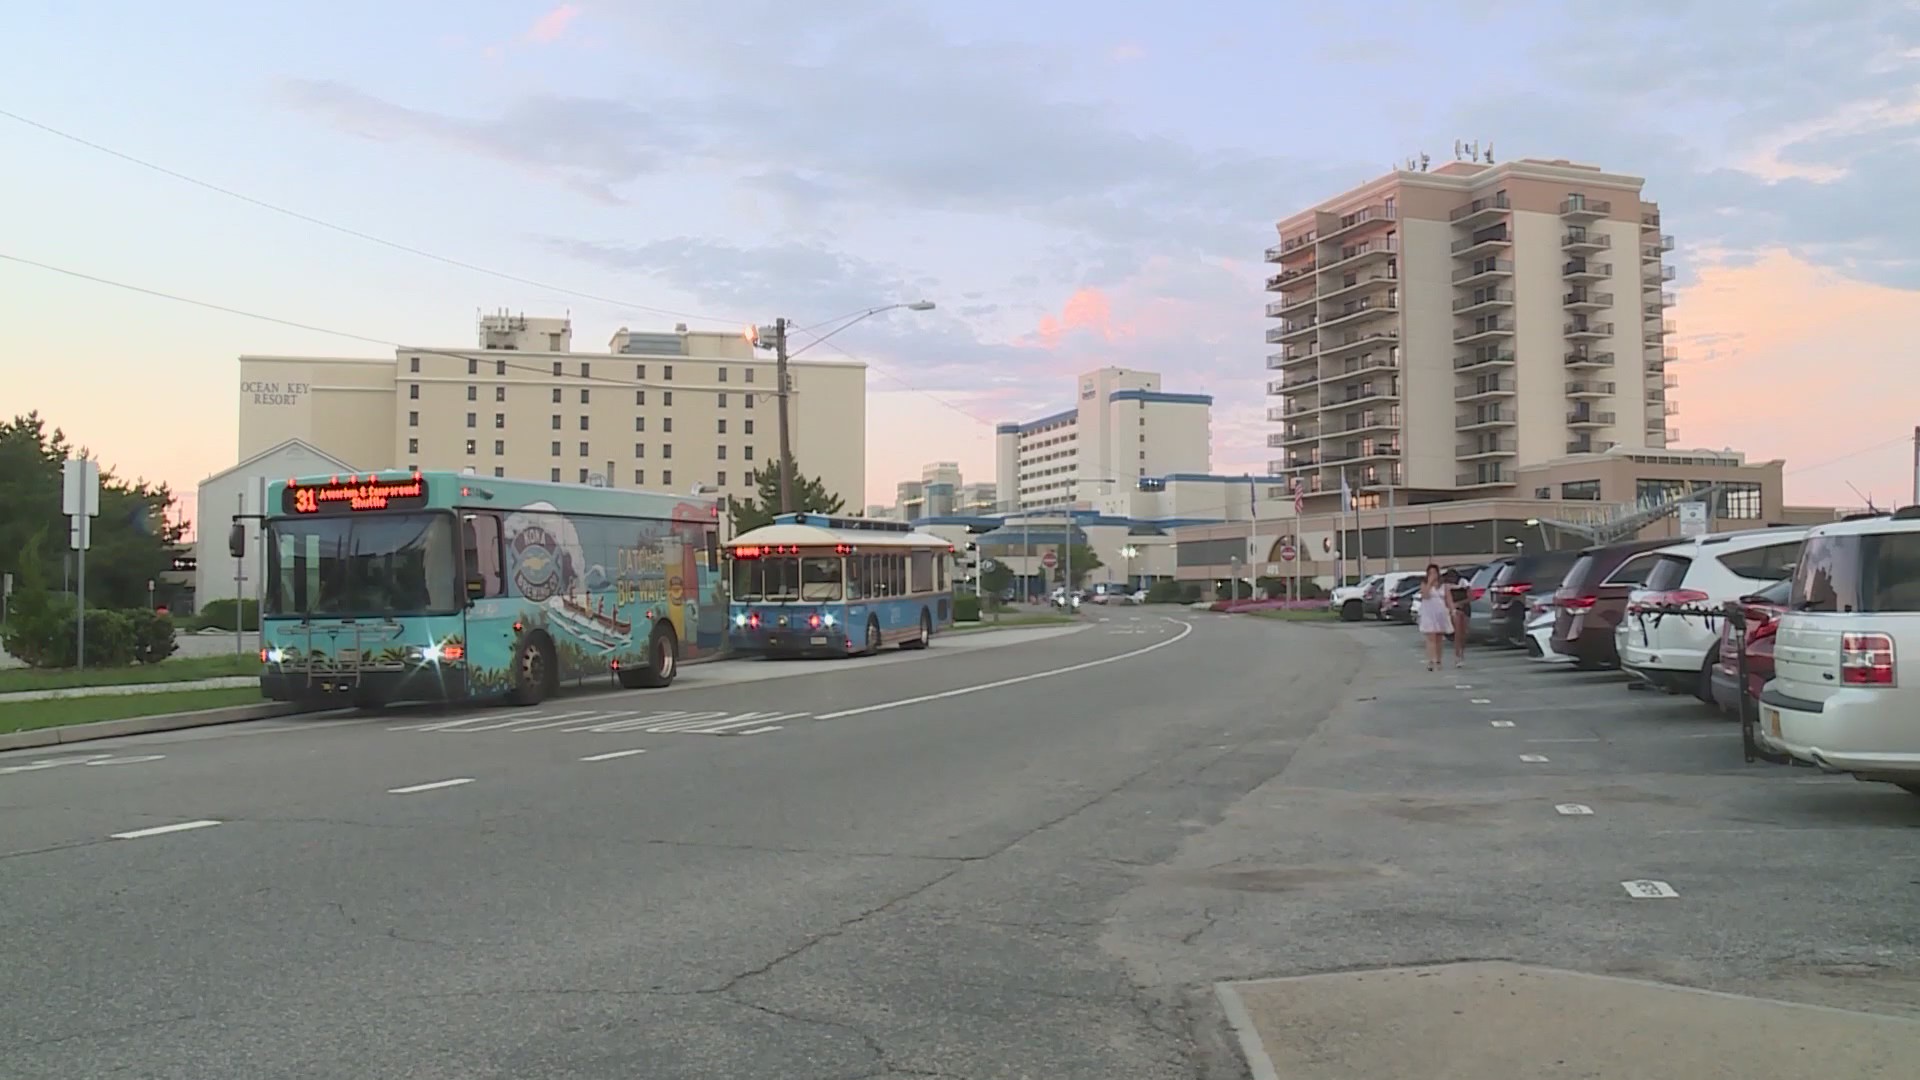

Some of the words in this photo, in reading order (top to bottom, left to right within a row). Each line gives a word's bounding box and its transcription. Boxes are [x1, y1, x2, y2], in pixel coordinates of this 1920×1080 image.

[240, 382, 280, 393] OCEAN
[287, 383, 310, 394] KEY
[254, 394, 298, 405] RESORT
[296, 488, 318, 512] 31
[618, 580, 636, 606] BIG
